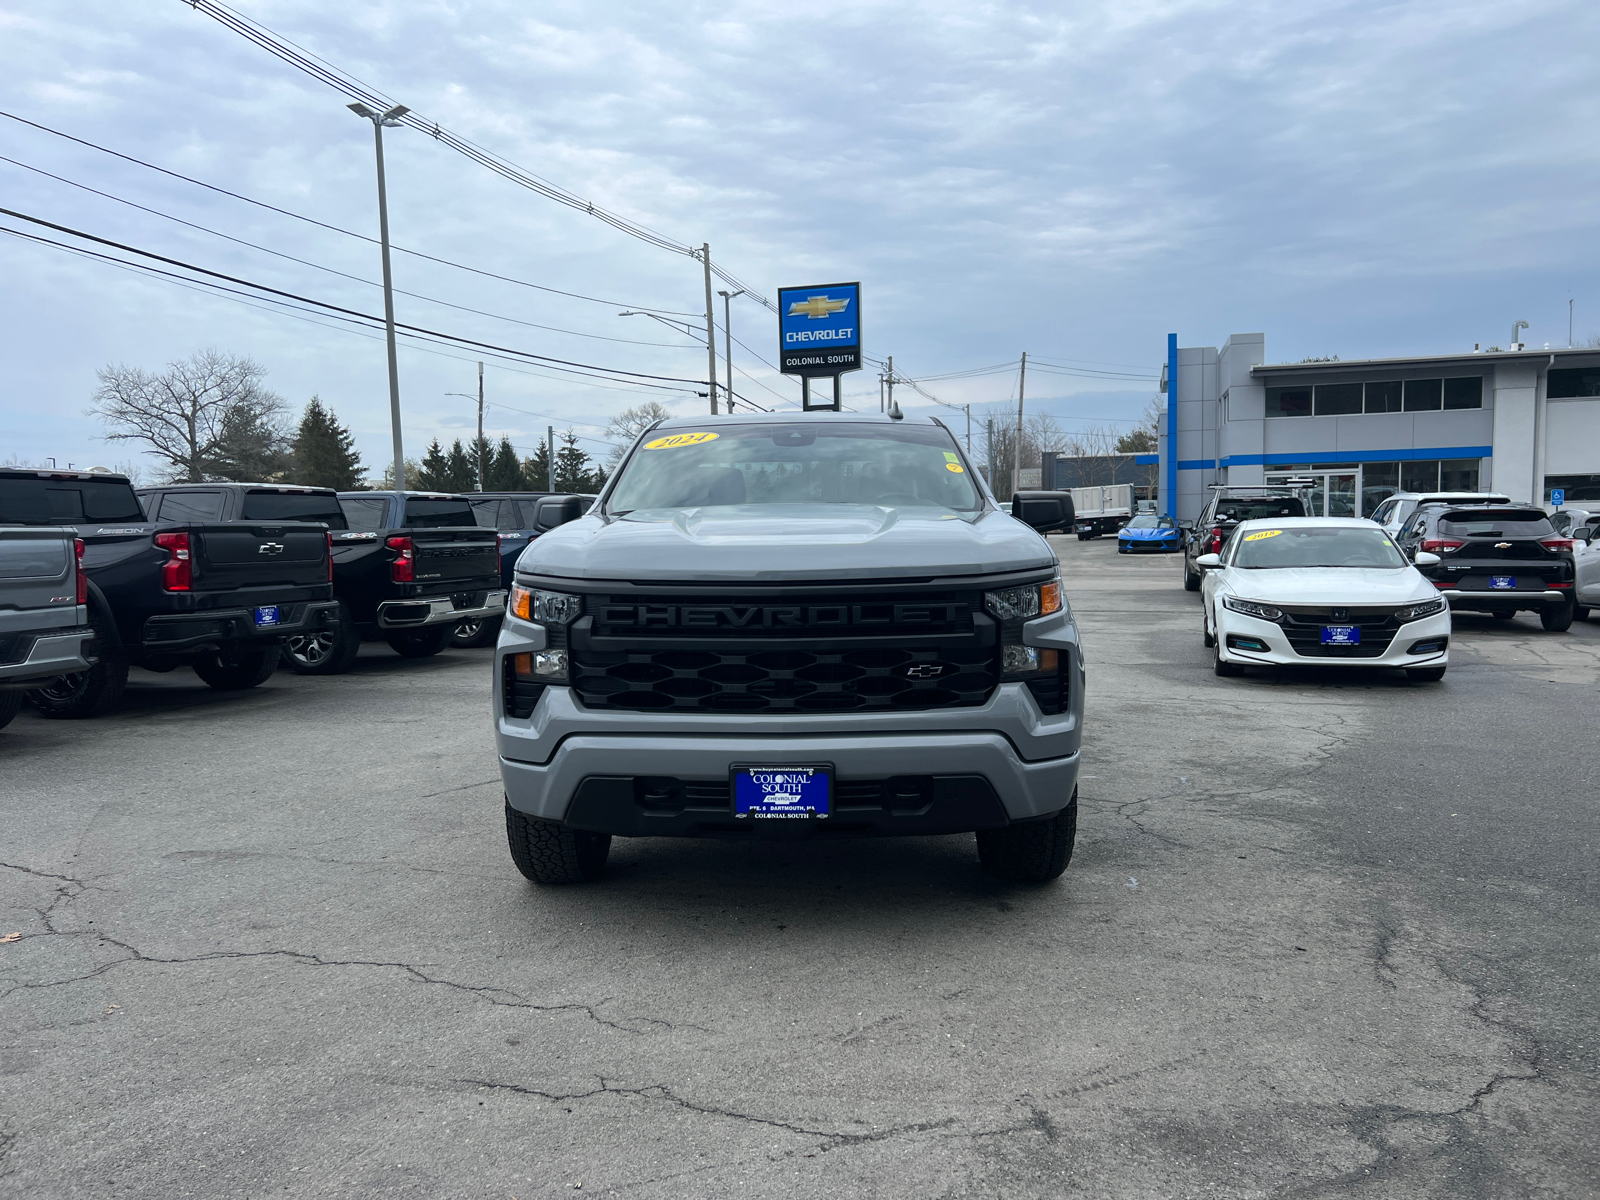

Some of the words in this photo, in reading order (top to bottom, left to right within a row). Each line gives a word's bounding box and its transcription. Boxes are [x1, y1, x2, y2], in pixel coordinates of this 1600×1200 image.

[786, 328, 853, 342] CHEVROLET
[786, 356, 825, 366] COLONIAL
[827, 354, 854, 364] SOUTH
[655, 433, 711, 448] 2024
[601, 602, 969, 627] CHEVROLET
[753, 774, 811, 784] COLONIAL
[762, 784, 802, 793] SOUTH
